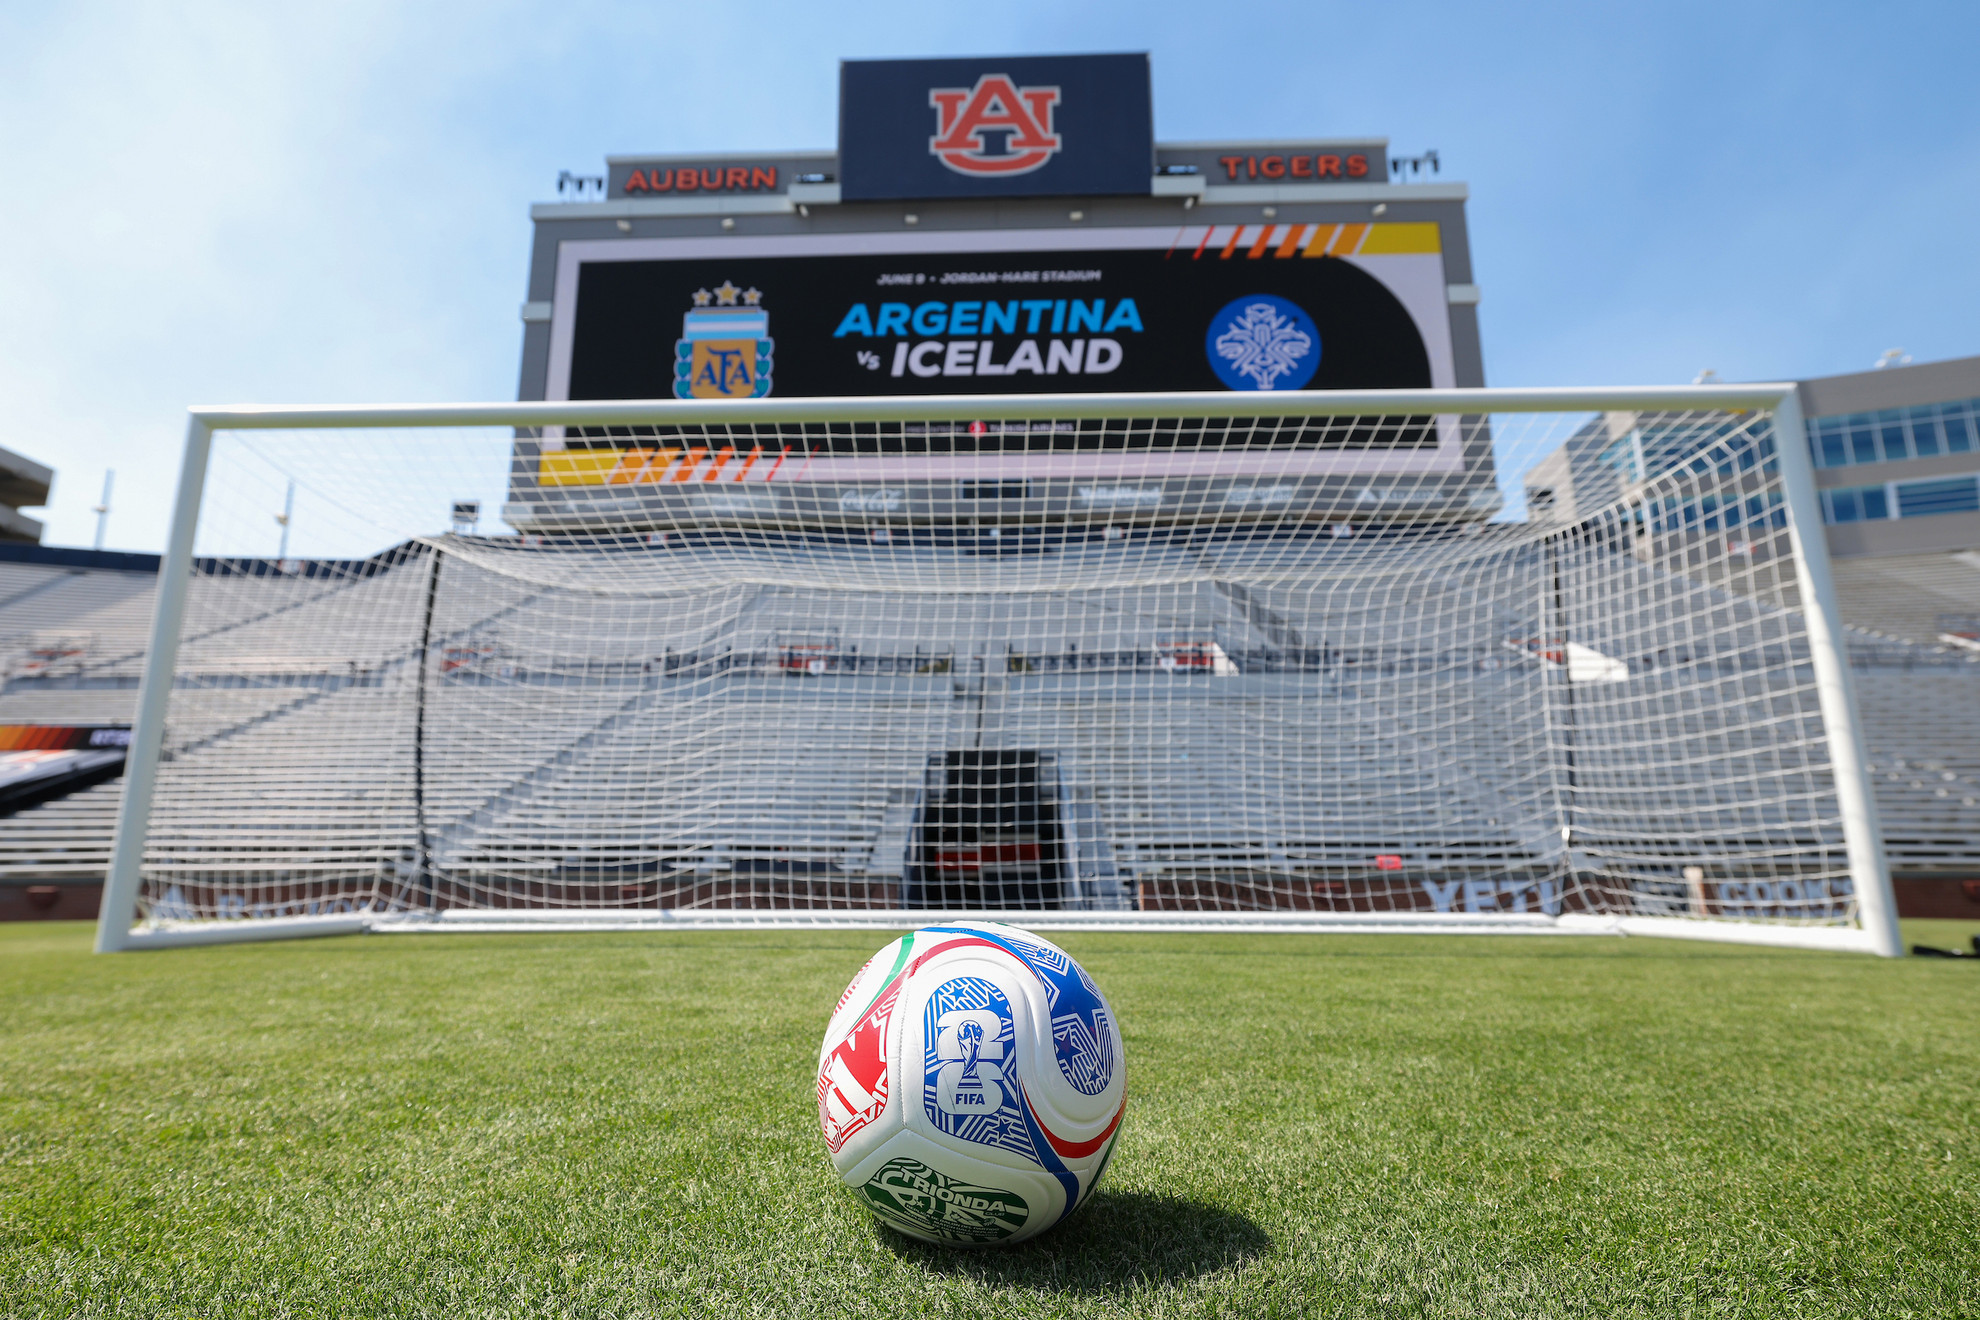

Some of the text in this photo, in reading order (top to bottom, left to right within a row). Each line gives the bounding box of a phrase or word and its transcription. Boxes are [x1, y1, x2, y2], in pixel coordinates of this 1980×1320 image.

[625, 166, 777, 192] AUBURN
[1220, 154, 1369, 180] TIGERS
[877, 273, 913, 286] JUNE
[1041, 269, 1102, 282] STADIUM
[832, 298, 1144, 337] ARGENTINA
[890, 338, 1124, 377] ICELAND
[1420, 880, 1556, 913] YETI
[955, 1093, 986, 1105] FIFA
[900, 1167, 1007, 1212] TRIONDA
